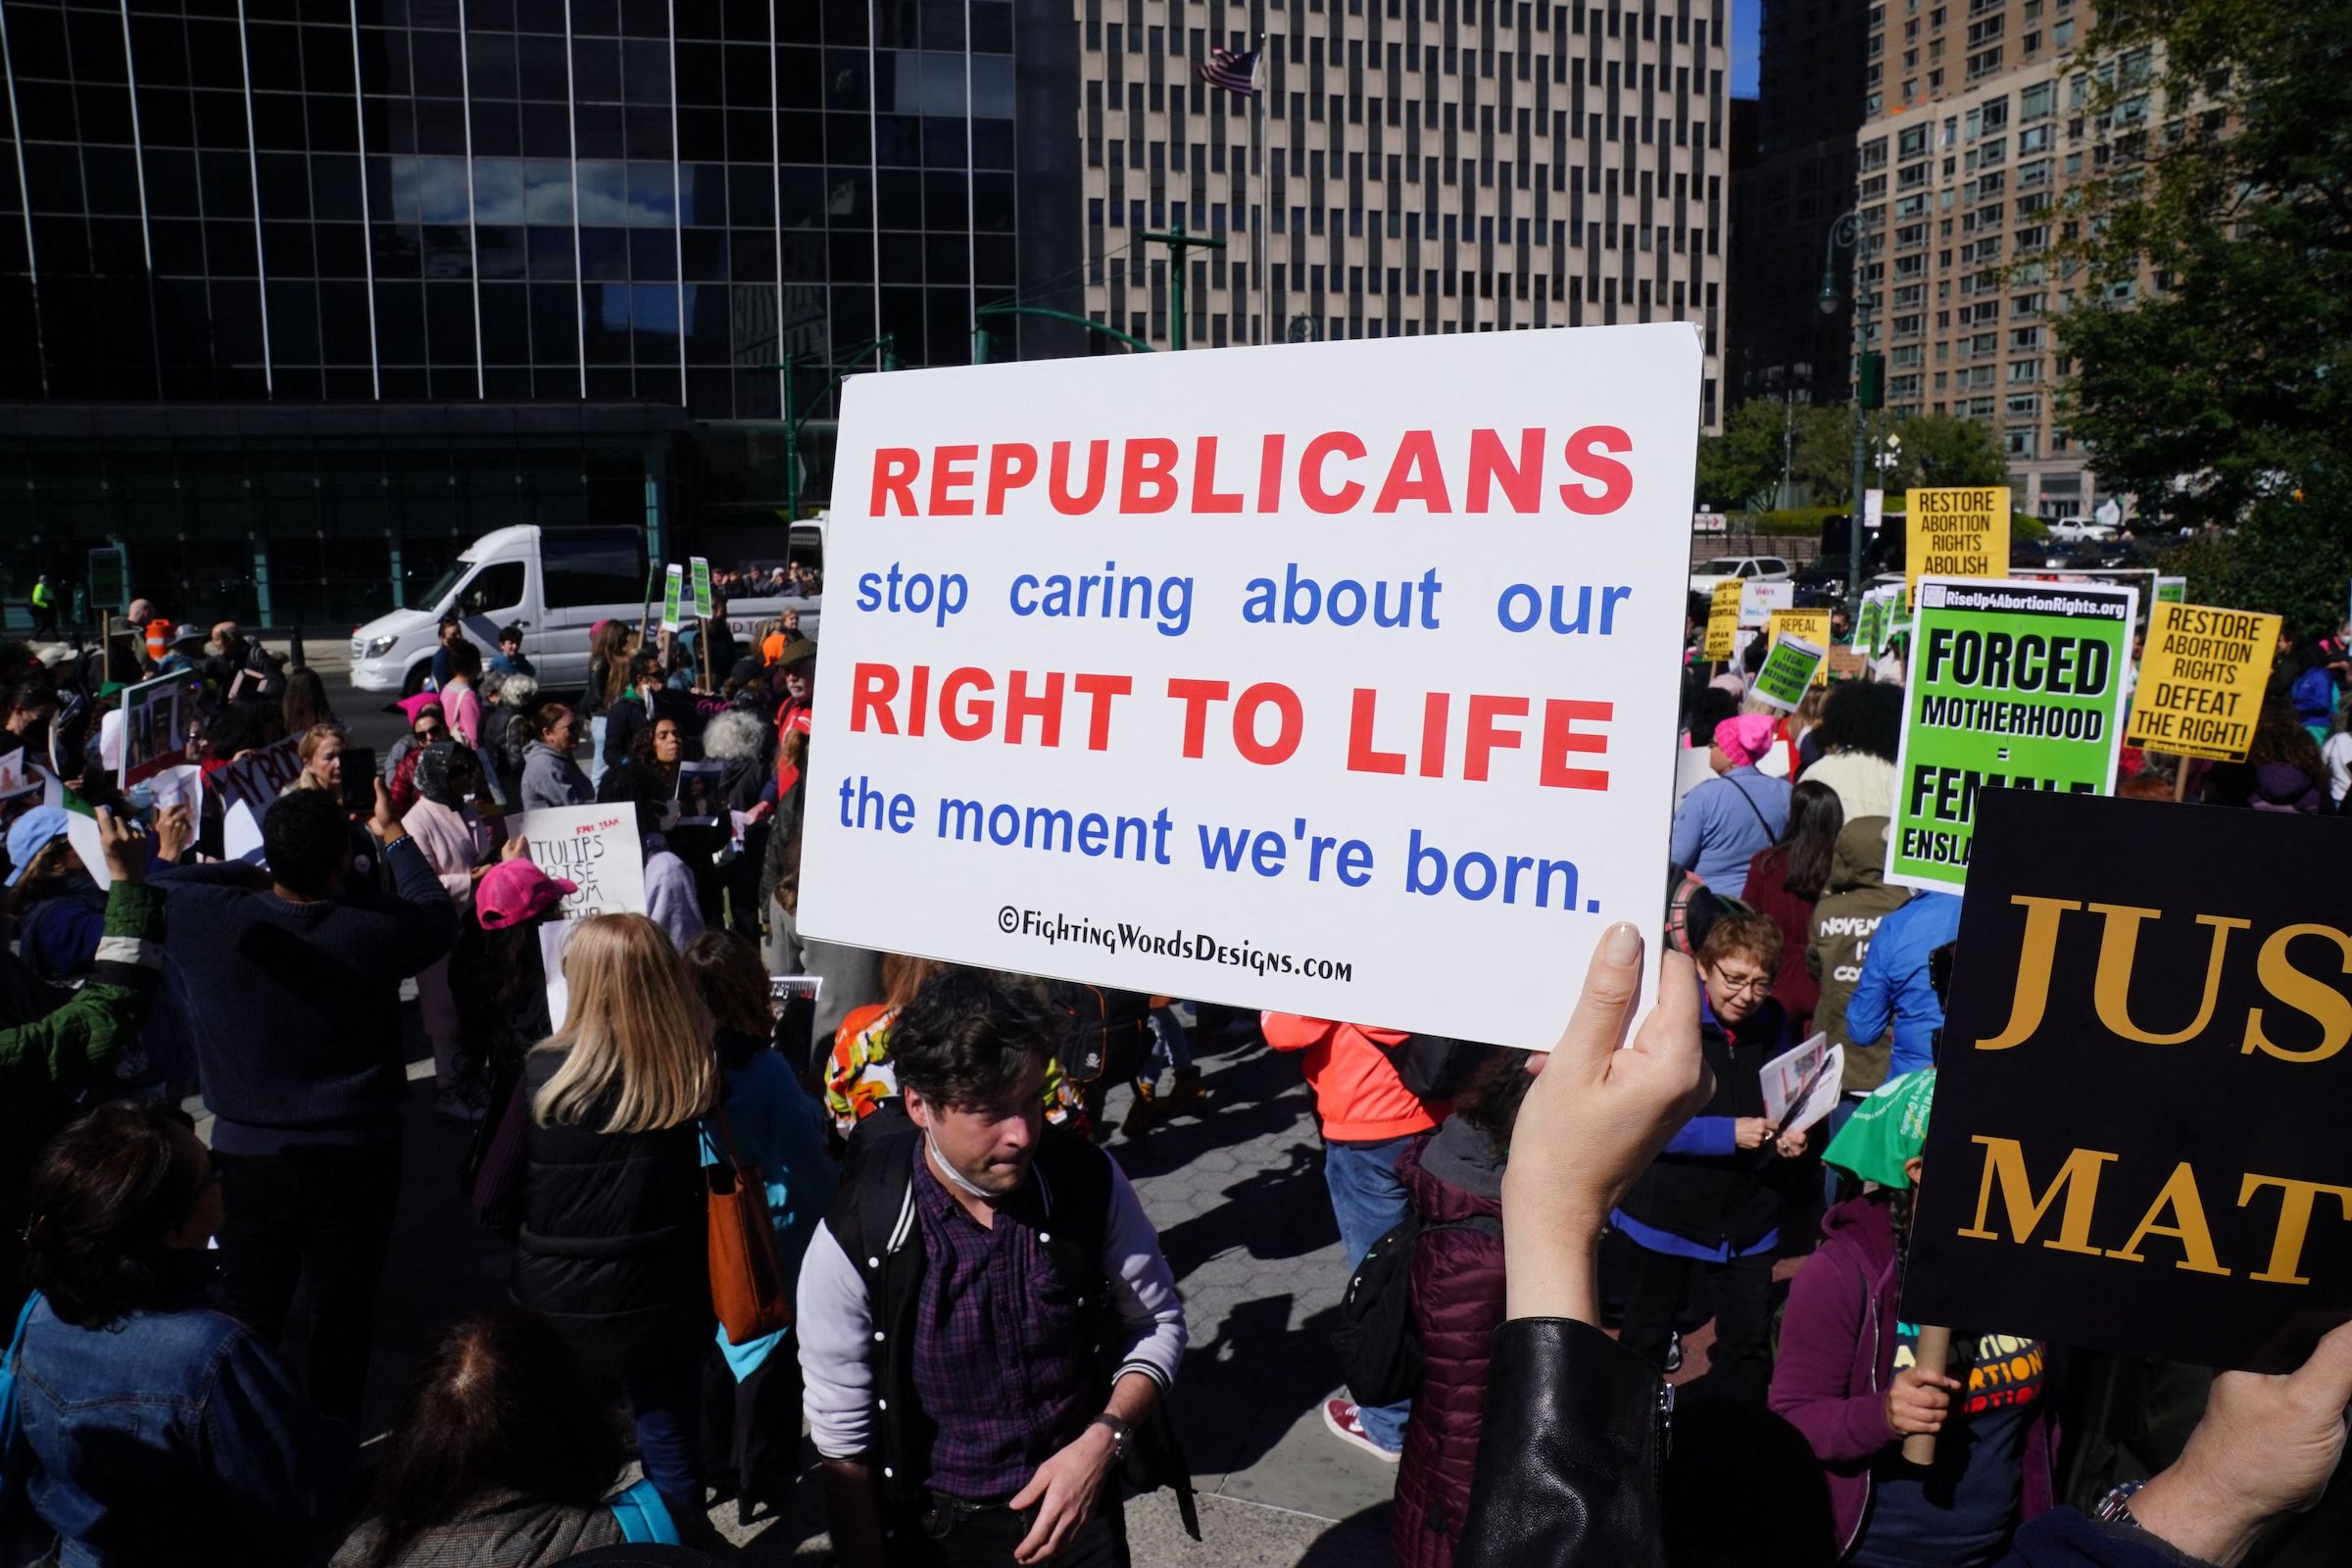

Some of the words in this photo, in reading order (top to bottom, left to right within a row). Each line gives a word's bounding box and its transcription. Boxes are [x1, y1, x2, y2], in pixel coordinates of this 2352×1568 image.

[869, 426, 1634, 516] REPUBLICANS
[1919, 491, 1995, 513] RESTORE
[1921, 514, 1990, 532] ABORTION
[1932, 534, 1982, 552] RIGHTS
[1924, 556, 1988, 575] ABOLISH
[856, 563, 969, 627] stop
[1009, 561, 1195, 637] caring
[1243, 563, 1444, 629] about
[1497, 583, 1633, 635] our
[1946, 591, 2126, 619] RiseUp4AbortionRights.org
[1780, 618, 1818, 633] REPEAL
[2167, 607, 2264, 641] RESTORE
[1926, 627, 2113, 698] FORCED
[2162, 634, 2253, 663] ABORTION
[2173, 658, 2238, 685] RIGHTS
[2155, 683, 2242, 717] DEFEAT
[850, 662, 1133, 751] RIGHT
[1166, 678, 1303, 765] TO
[1347, 688, 1614, 791] LIFE
[1921, 695, 2105, 743] MOTHERHOOD
[2136, 710, 2176, 737] THE
[2179, 716, 2248, 748] RIGHT!
[531, 835, 605, 864] TULIPS
[839, 775, 916, 834] the
[938, 799, 1174, 865] moment
[1199, 817, 1374, 887] we're
[1405, 828, 1600, 913] born.
[1976, 896, 2352, 1063] JUS
[1957, 1135, 2352, 1285] MAT
